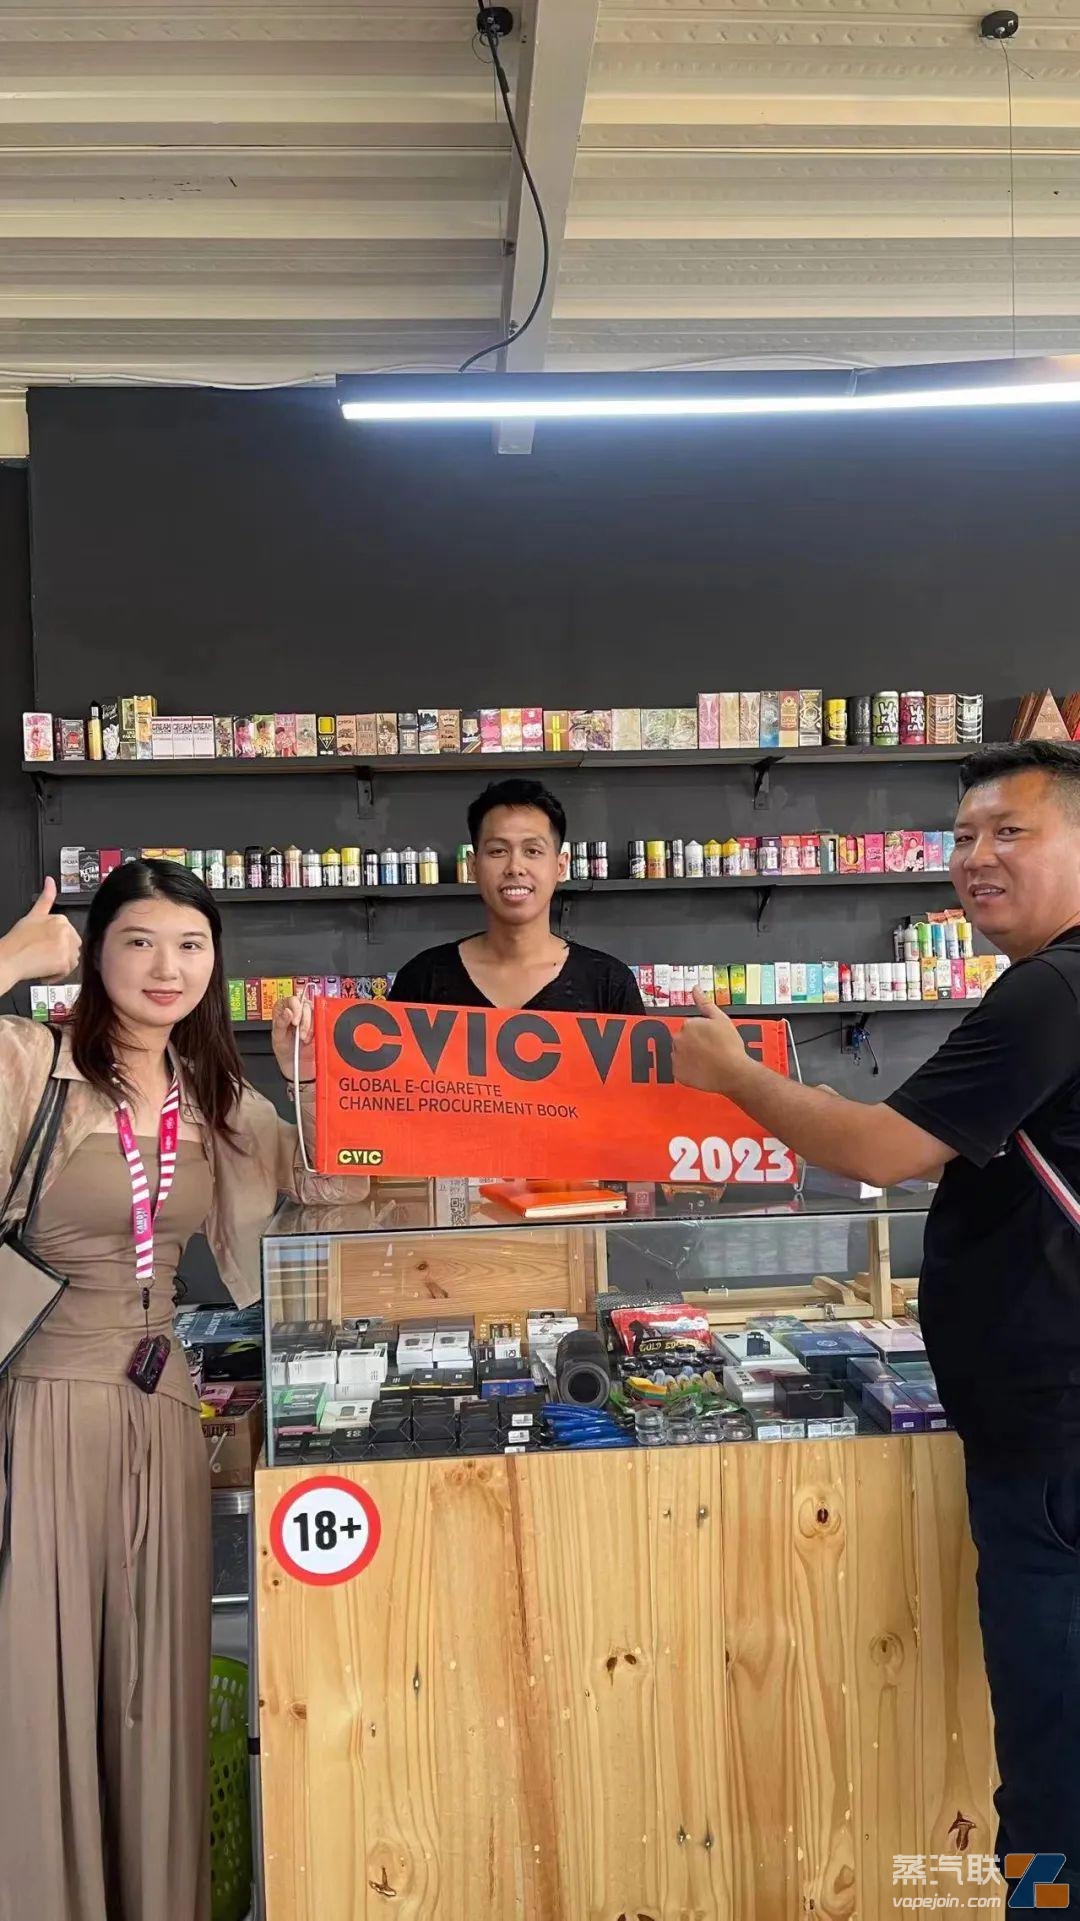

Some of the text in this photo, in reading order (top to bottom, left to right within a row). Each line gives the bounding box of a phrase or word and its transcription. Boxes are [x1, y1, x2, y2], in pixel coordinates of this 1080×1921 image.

[333, 1003, 763, 1085] CVIC VAE
[339, 1077, 502, 1097] GLOBAL E-CIGARETTE
[339, 1096, 579, 1119] CHANNEL PROCUREMENT BOOK
[338, 1150, 383, 1165] CVIC
[668, 1136, 794, 1182] 2023
[639, 1341, 662, 1352] GOLD
[293, 1510, 362, 1551] 18+
